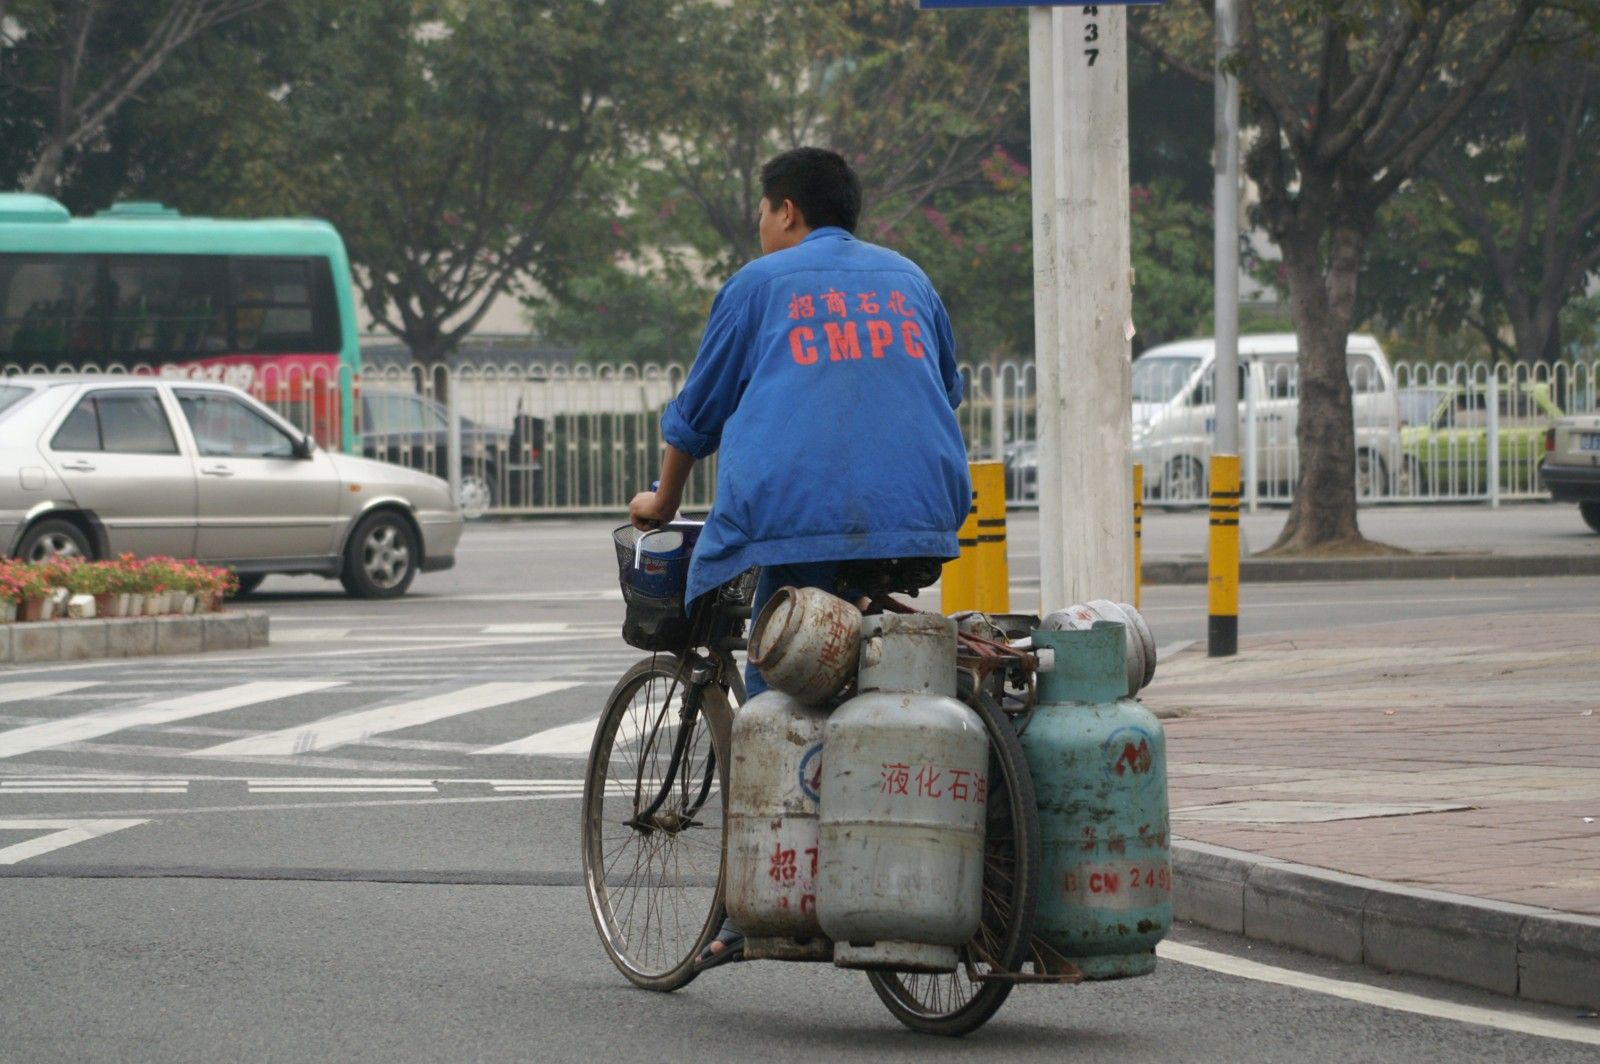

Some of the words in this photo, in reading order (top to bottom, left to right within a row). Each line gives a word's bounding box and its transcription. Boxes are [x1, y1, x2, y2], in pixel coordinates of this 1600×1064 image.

[788, 288, 916, 320] 招商石化
[788, 319, 925, 365] CMPC
[880, 762, 986, 804] 液化石油
